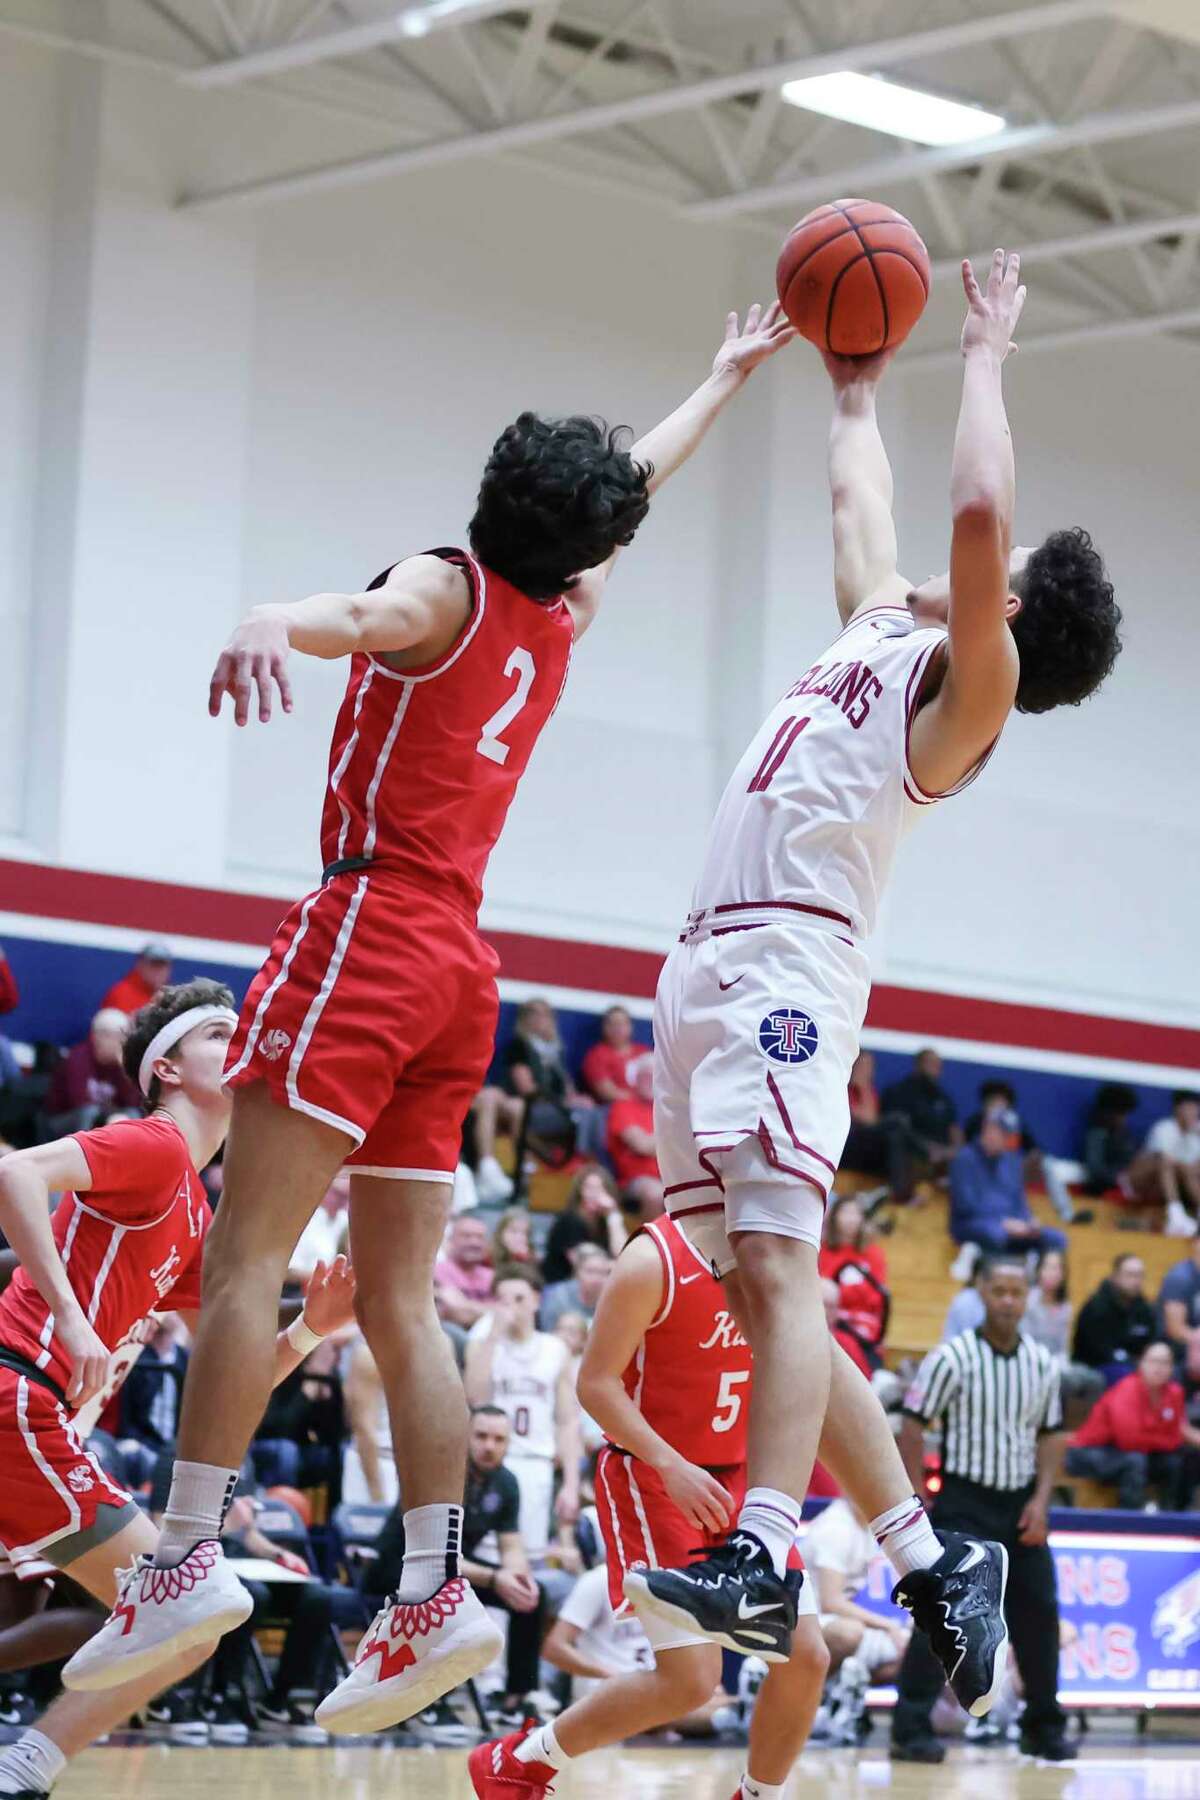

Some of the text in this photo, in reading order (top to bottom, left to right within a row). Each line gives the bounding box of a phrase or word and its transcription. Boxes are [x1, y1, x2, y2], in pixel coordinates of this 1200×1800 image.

[475, 645, 537, 766] 2
[746, 715, 811, 793] 11
[771, 1015, 808, 1055] T
[514, 1406, 530, 1437] 0
[711, 1370, 750, 1433] 5
